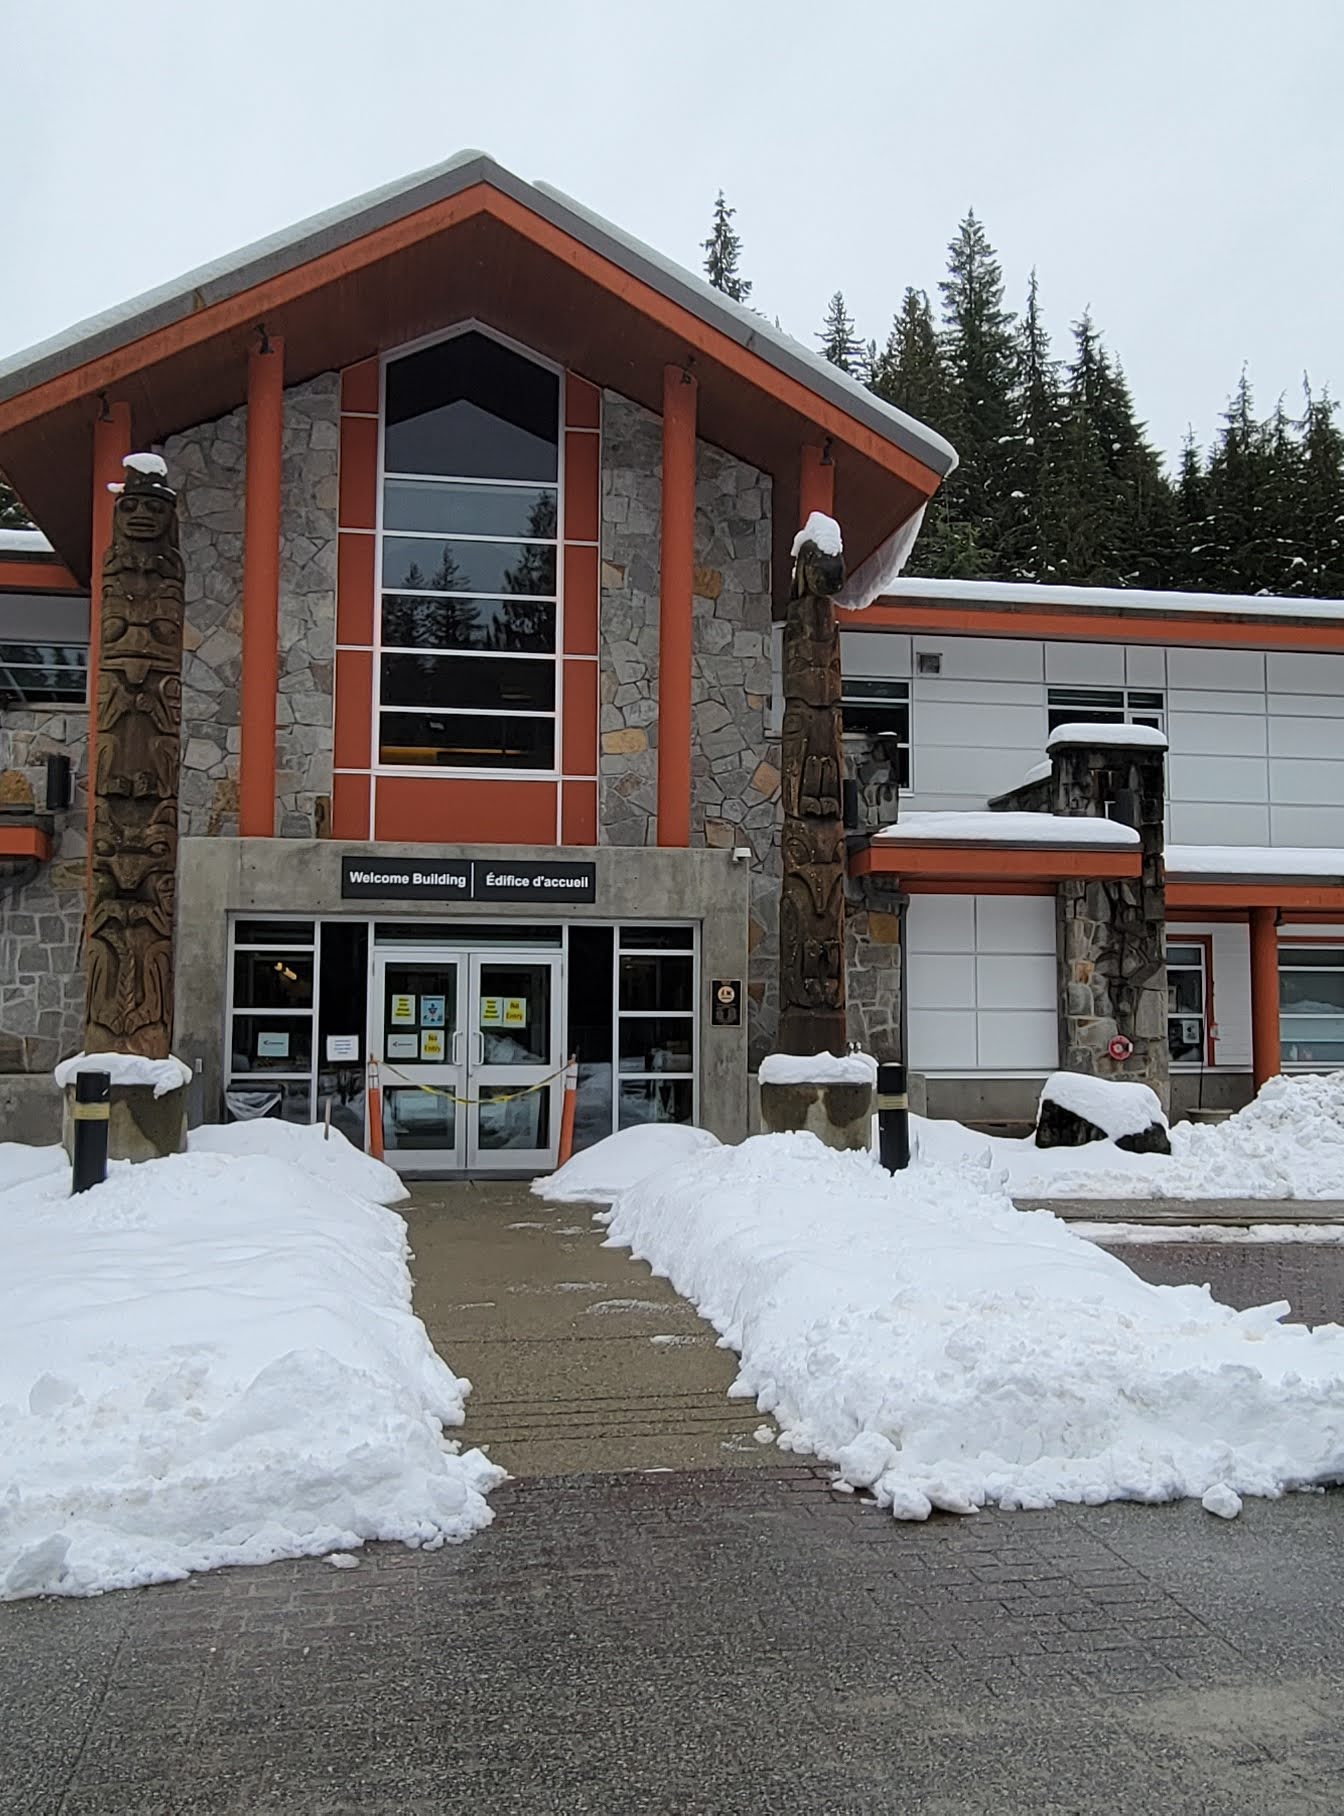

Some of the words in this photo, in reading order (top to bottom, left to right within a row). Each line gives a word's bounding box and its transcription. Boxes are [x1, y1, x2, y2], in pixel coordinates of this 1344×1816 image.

[349, 871, 409, 884] Welcome
[412, 872, 466, 888] Building
[486, 872, 530, 887] Édifice
[532, 875, 589, 888] d'accueil
